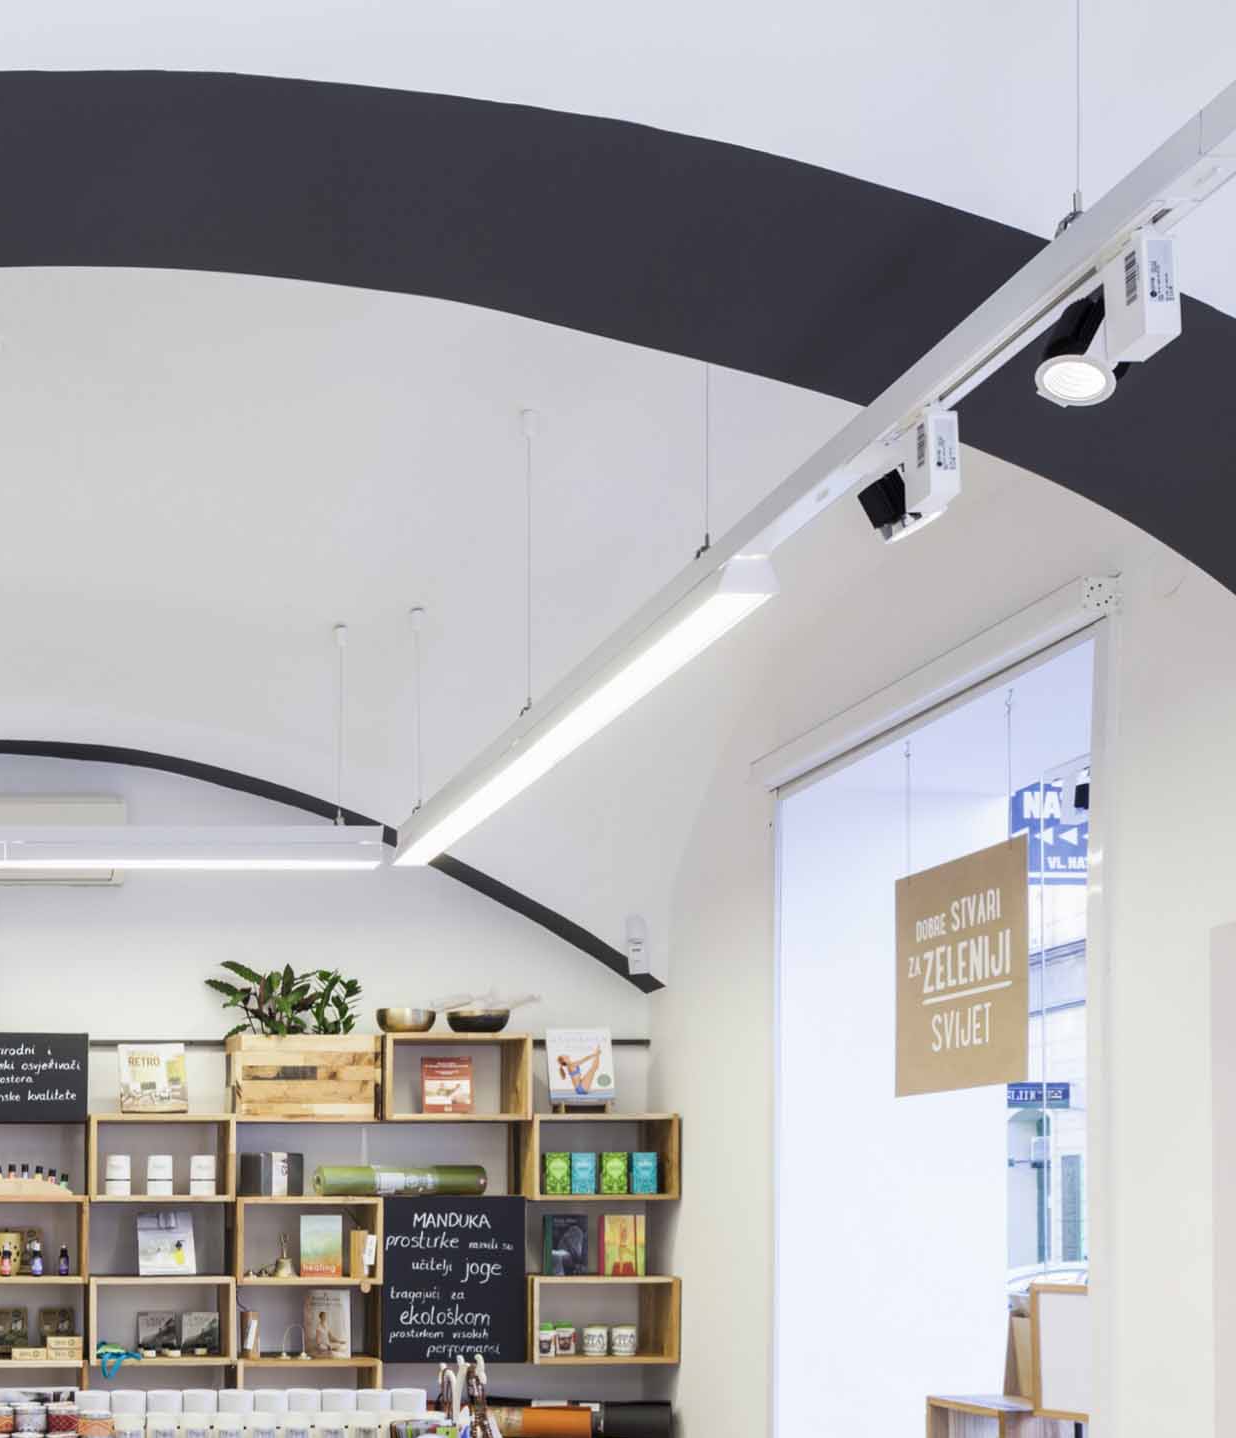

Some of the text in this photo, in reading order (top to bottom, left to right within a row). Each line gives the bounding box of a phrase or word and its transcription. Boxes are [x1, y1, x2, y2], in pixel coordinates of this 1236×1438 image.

[1023, 791, 1061, 819] NA
[916, 888, 1001, 943] DOBRE STVARI
[908, 928, 1012, 994] ZA ZELENIJI
[932, 1002, 992, 1052] SVIJET
[412, 1212, 492, 1229] MANDUKA
[385, 1231, 460, 1251] prostirke
[460, 1258, 502, 1284] joge
[400, 1303, 491, 1326] ekološkom
